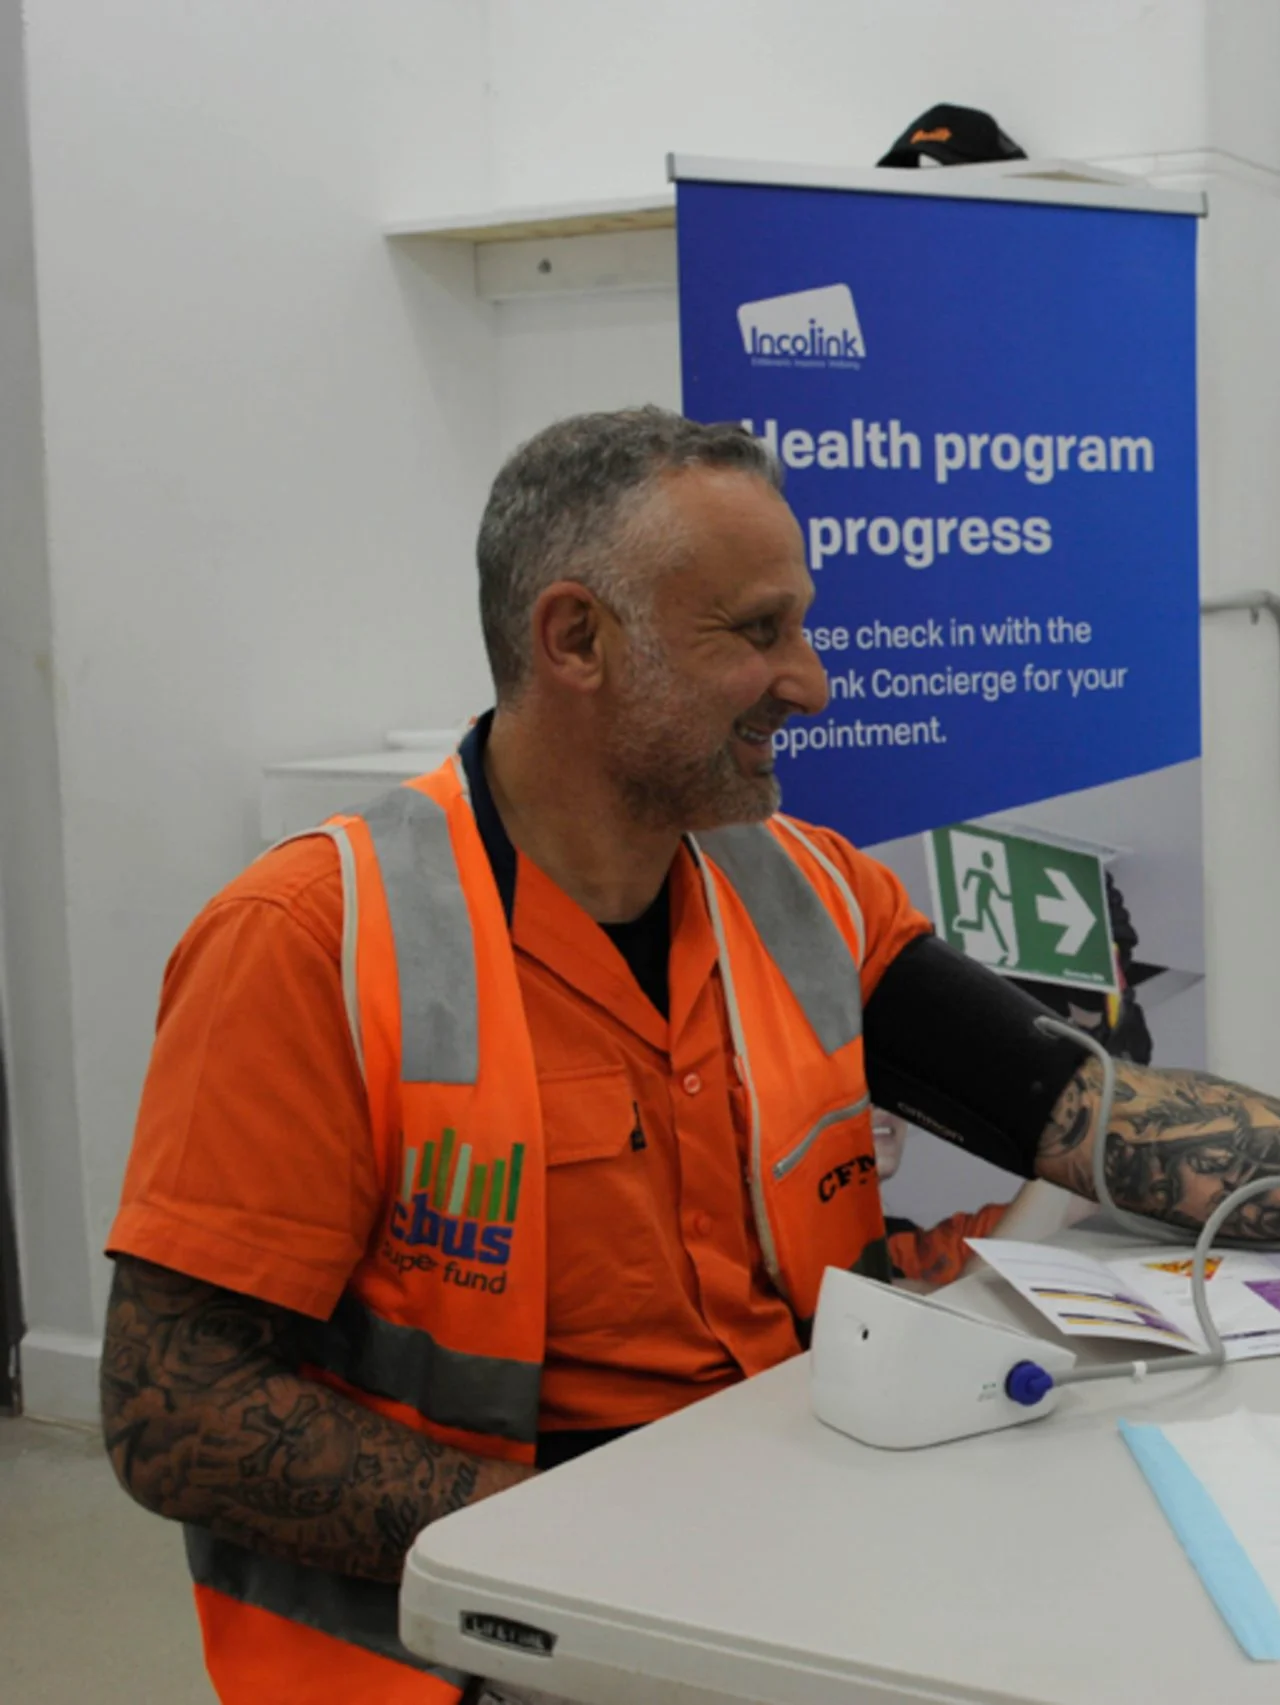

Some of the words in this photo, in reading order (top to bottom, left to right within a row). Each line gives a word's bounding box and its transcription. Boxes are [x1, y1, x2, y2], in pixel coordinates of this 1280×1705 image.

[751, 318, 858, 357] Incolink
[934, 430, 1155, 484] program
[808, 514, 1053, 570] progress
[856, 619, 944, 650] check
[950, 618, 975, 646] in
[981, 617, 1042, 646] with
[1047, 616, 1092, 645] the
[871, 667, 1018, 701] Concierge
[1023, 664, 1062, 691] for
[1067, 667, 1128, 697] your
[770, 717, 947, 759] ppointment.
[818, 1154, 876, 1204] CFM
[389, 1193, 514, 1266] cbus
[443, 1261, 507, 1295] fund
